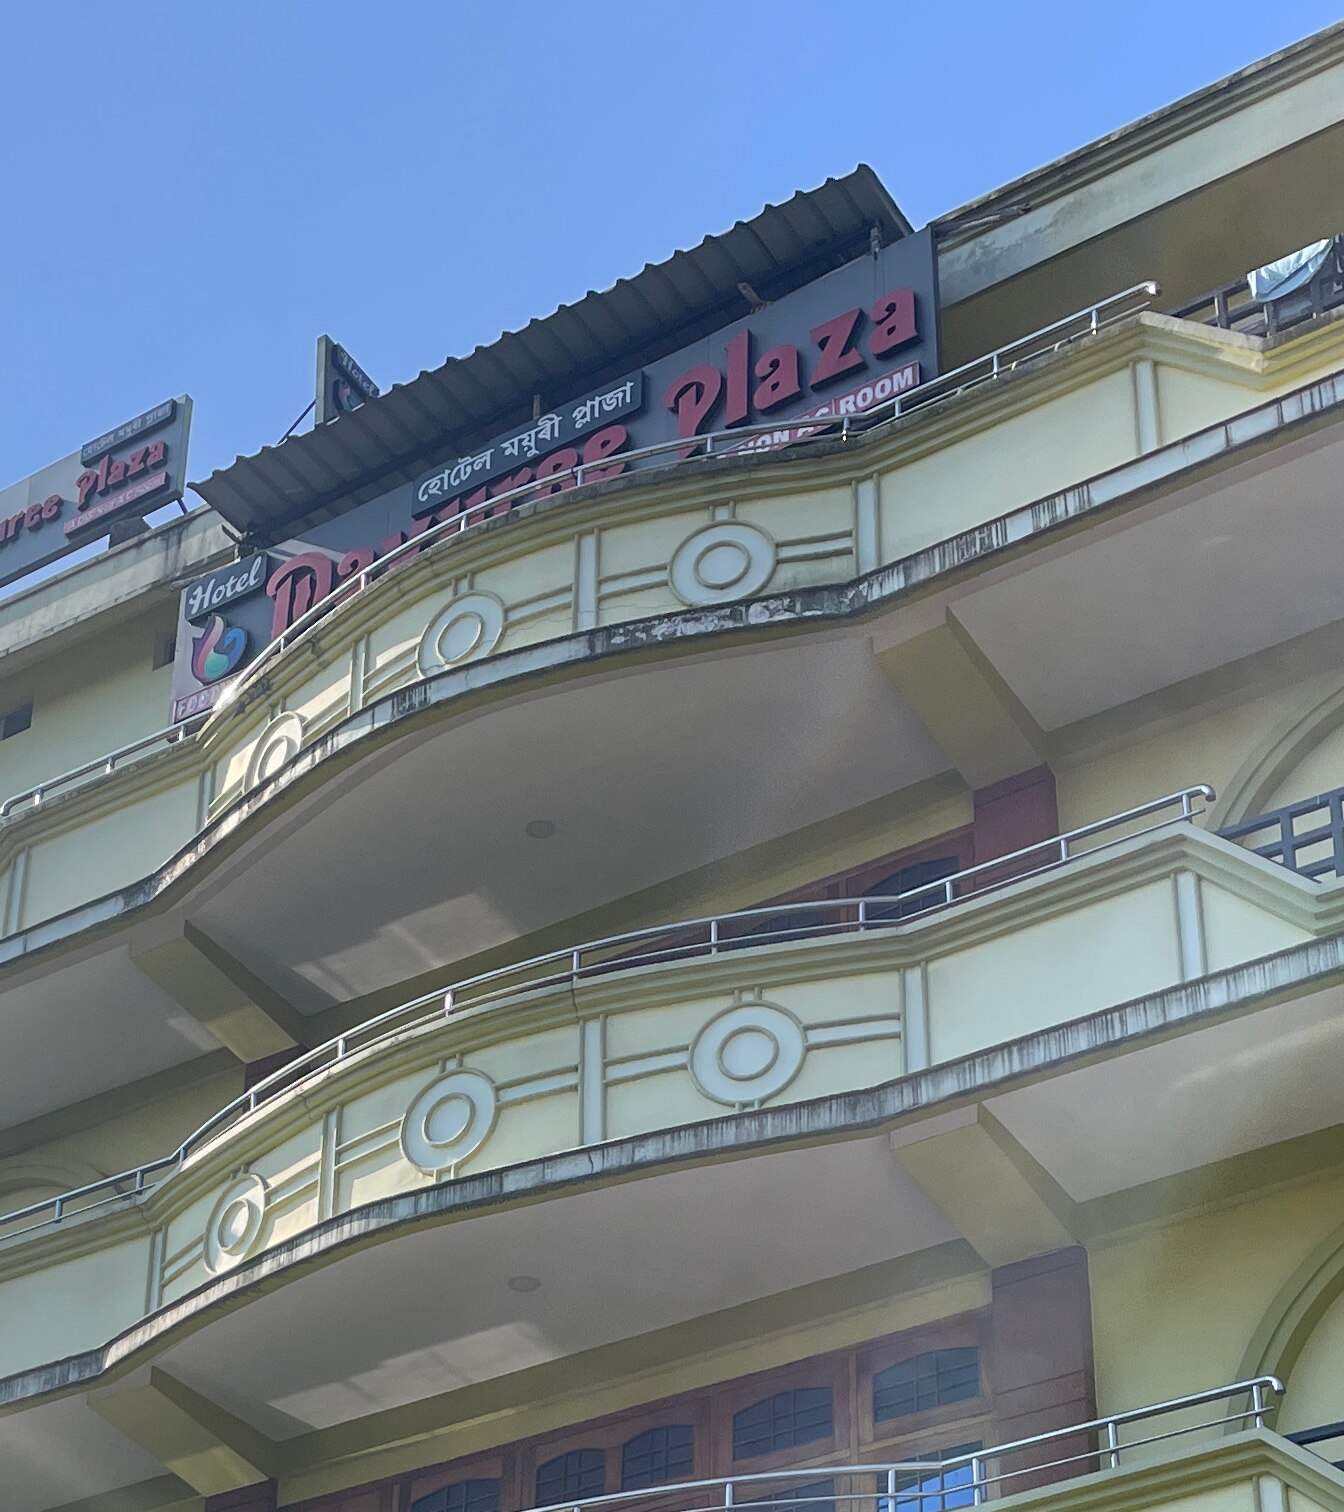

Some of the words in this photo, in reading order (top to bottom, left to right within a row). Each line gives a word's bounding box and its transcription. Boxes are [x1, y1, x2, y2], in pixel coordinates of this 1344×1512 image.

[664, 287, 917, 458] Plaza
[840, 366, 913, 415] ROOM
[76, 440, 164, 506] Plaza
[418, 449, 494, 501] হোটেল
[571, 381, 634, 429] প্লাজা
[189, 556, 261, 615] Hotel
